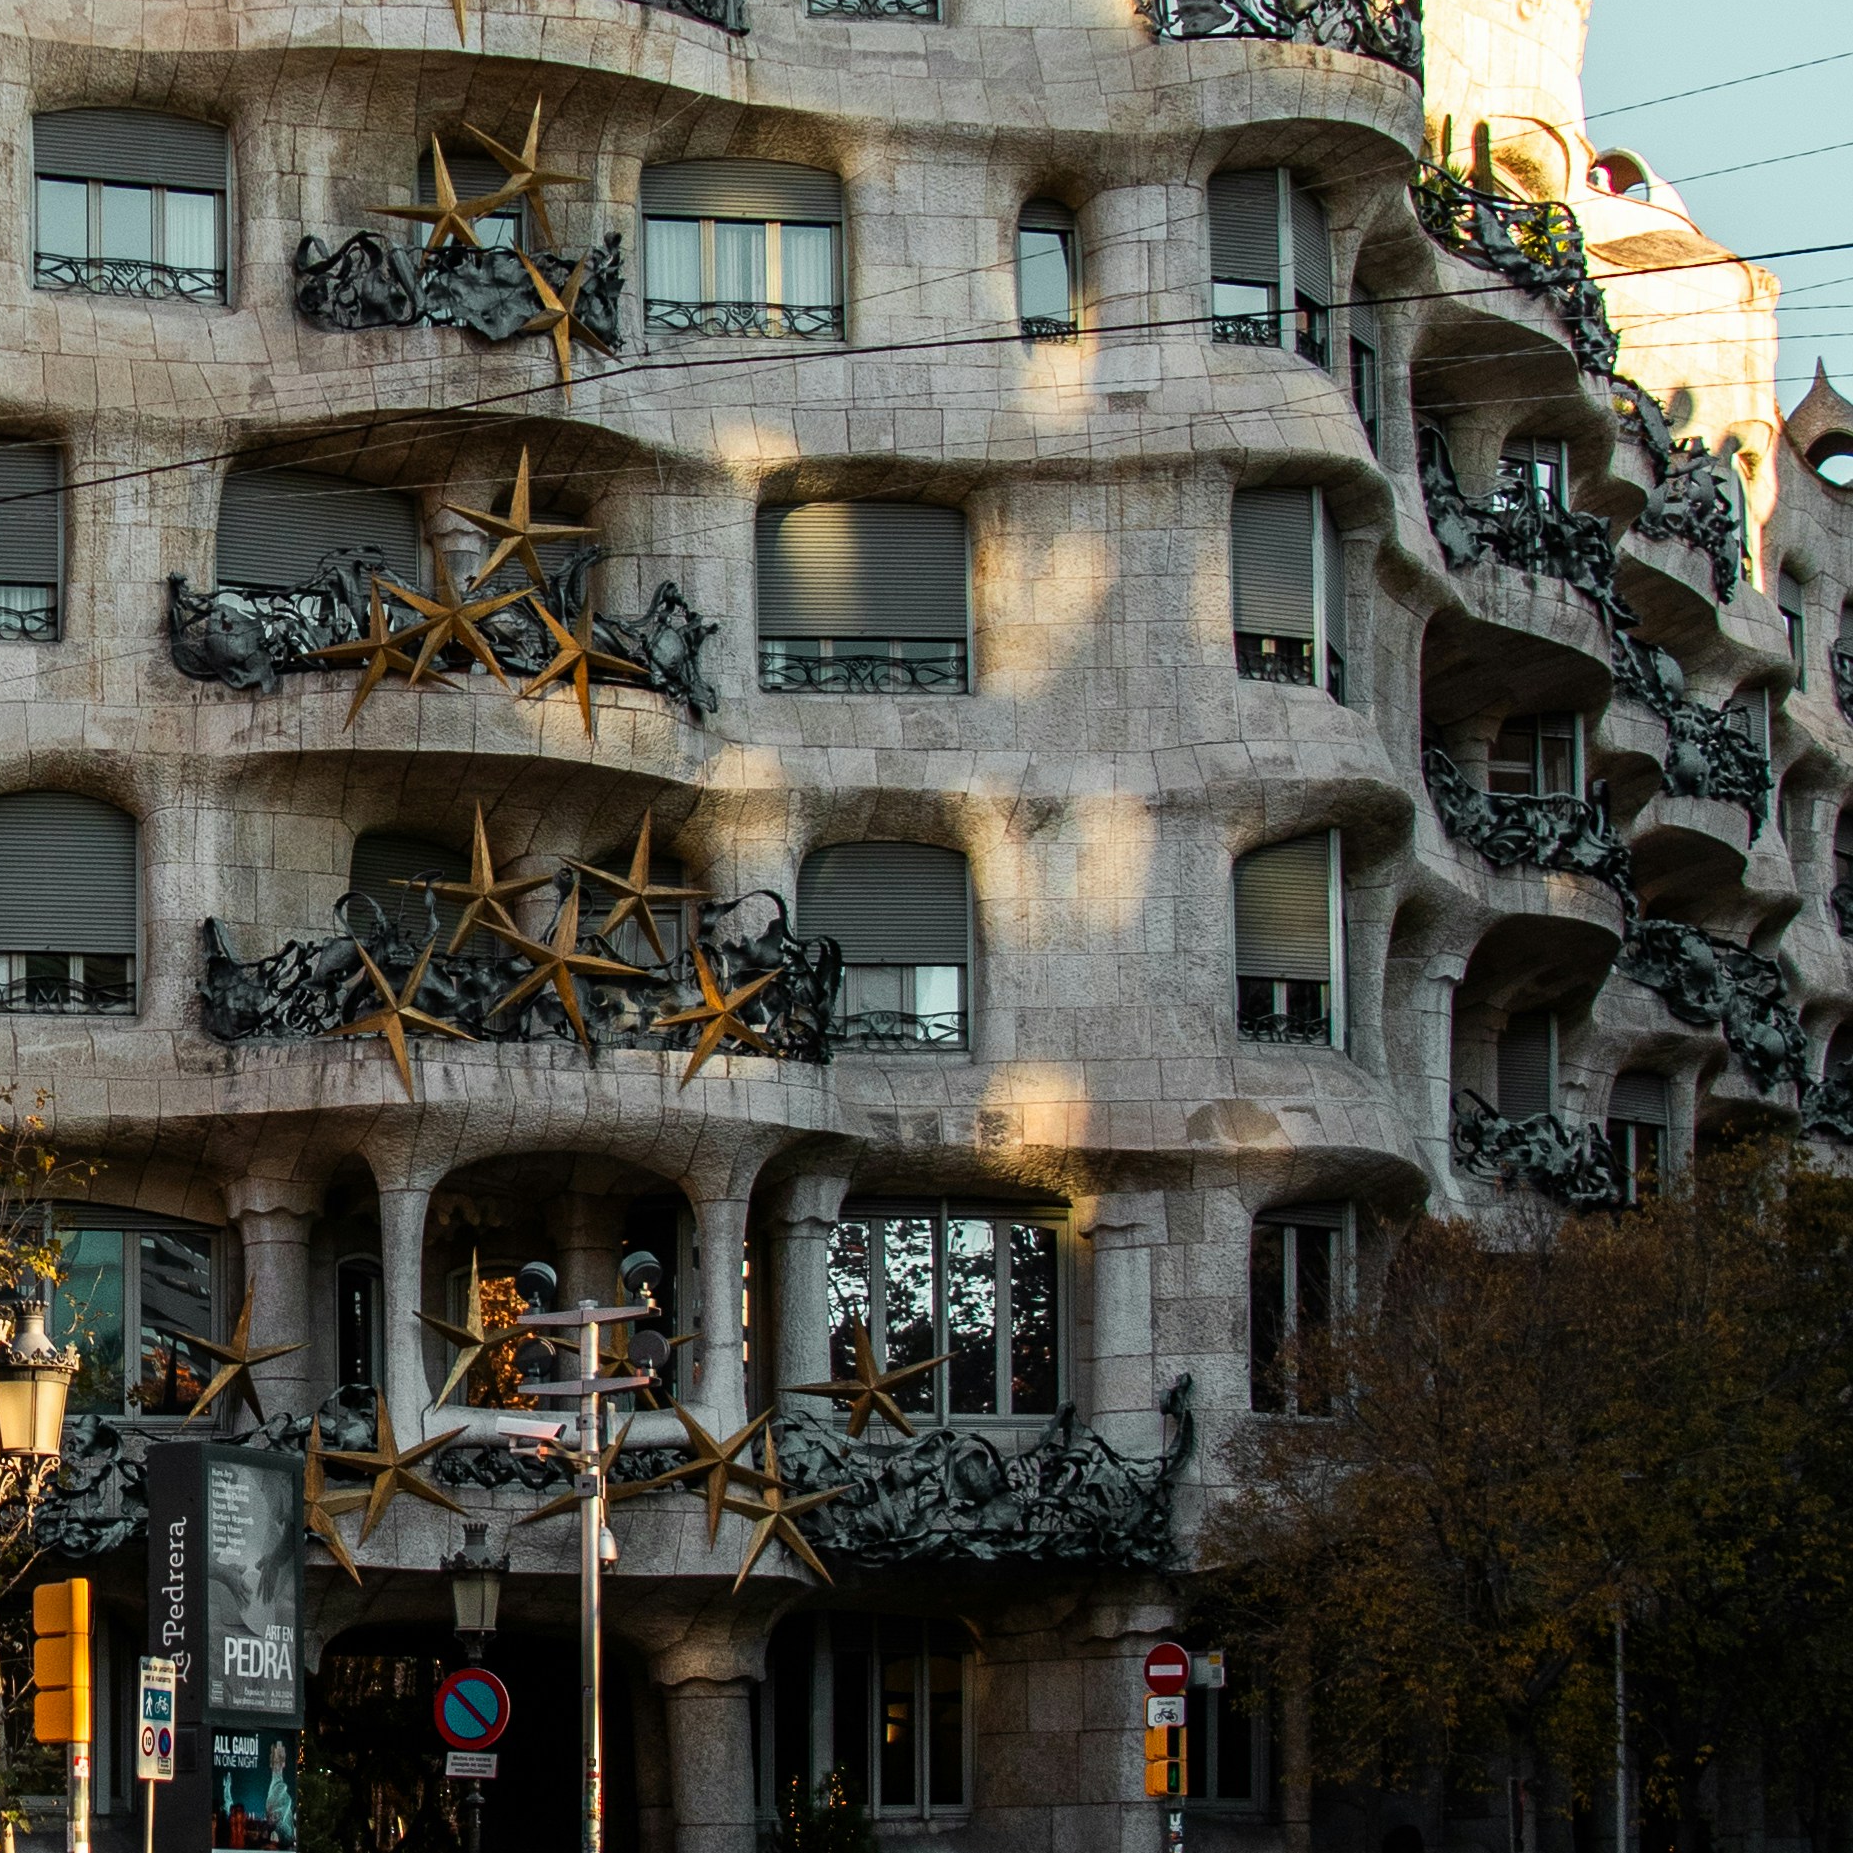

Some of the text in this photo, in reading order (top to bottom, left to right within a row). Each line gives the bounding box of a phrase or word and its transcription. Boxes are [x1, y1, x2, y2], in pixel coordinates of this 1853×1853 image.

[162, 1516, 187, 1646] Pedrera
[265, 1624, 294, 1643] ART EN
[224, 1636, 293, 1681] PEDRA
[214, 1733, 259, 1756] ALL GAUDÍ
[214, 1754, 259, 1768] IN ONE NIGHT
